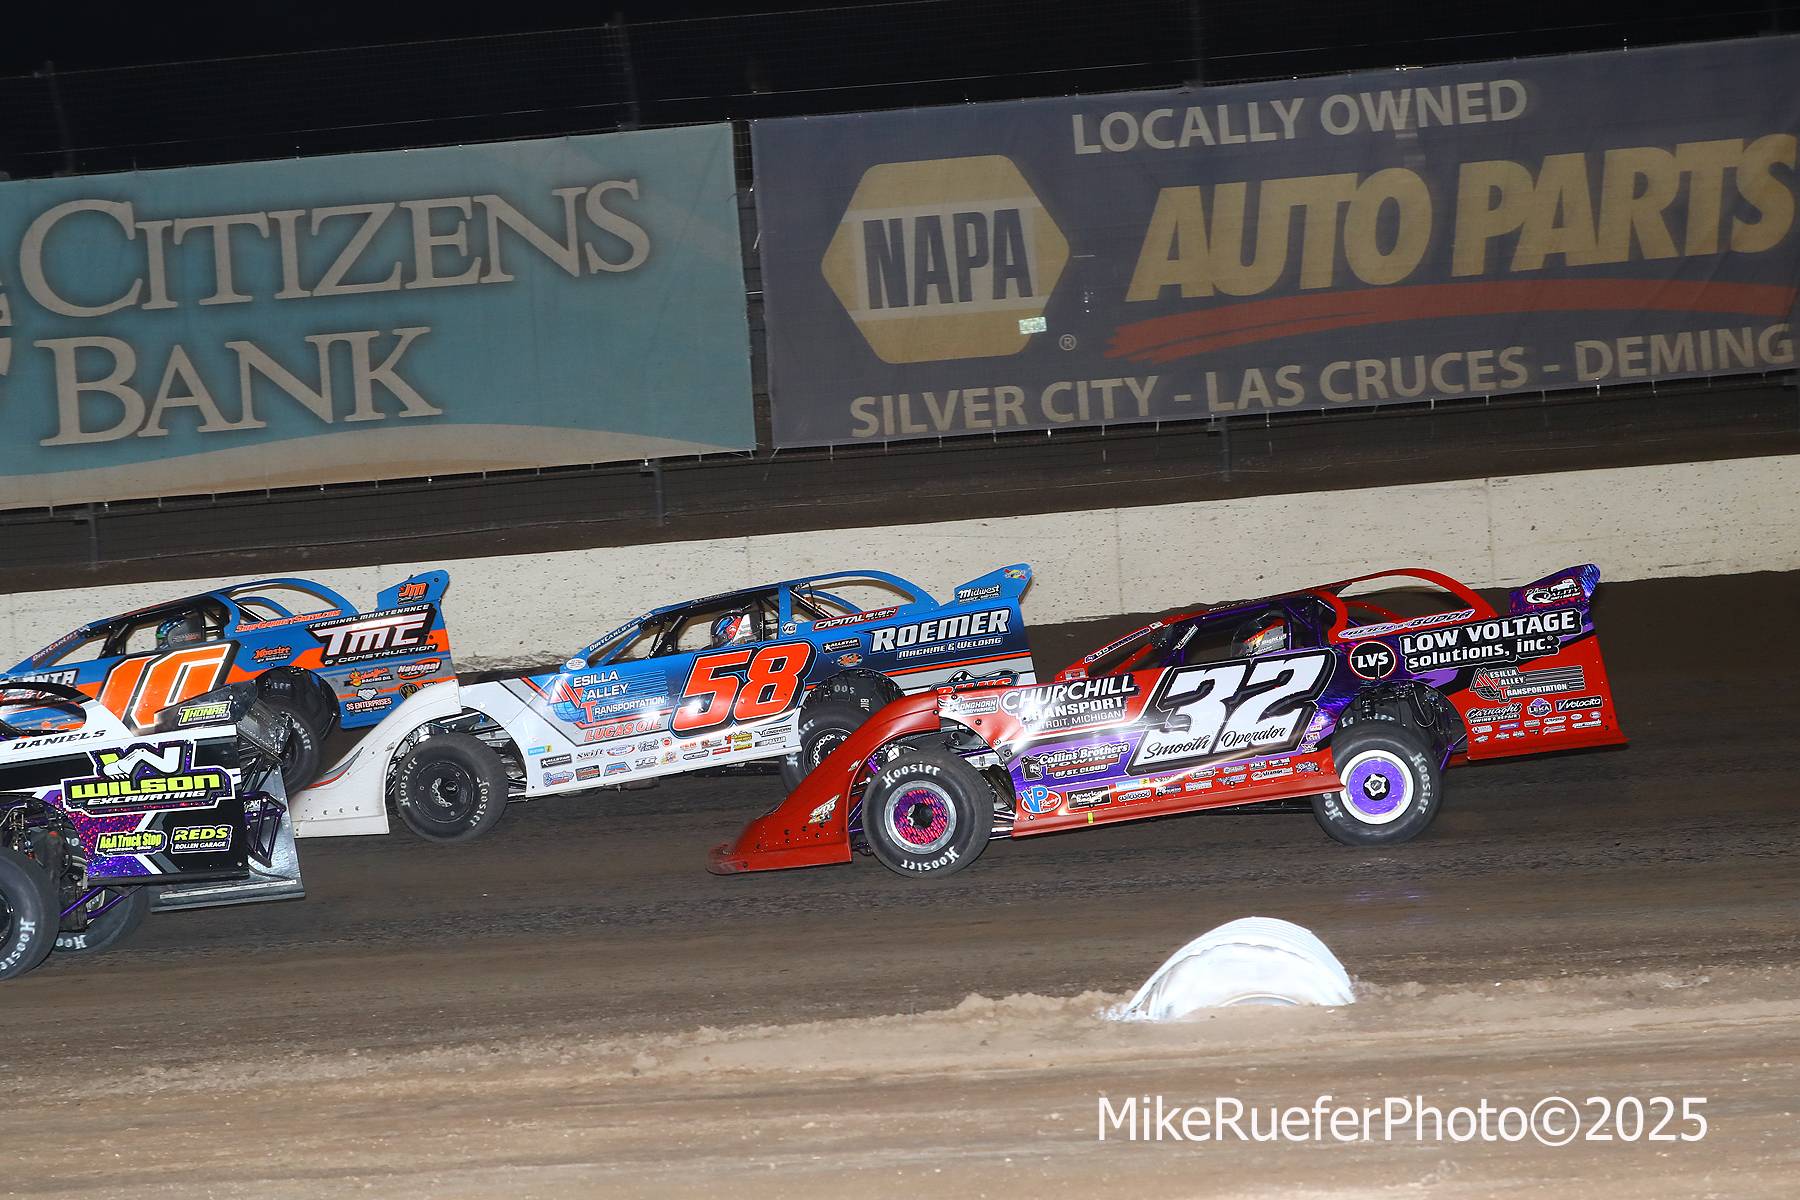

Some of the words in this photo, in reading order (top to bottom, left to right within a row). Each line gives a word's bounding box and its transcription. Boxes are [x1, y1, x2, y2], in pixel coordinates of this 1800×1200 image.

[1073, 96, 1304, 155] LOCALLY
[1320, 79, 1527, 137] OWNED
[1126, 167, 1432, 302] AUTO
[1452, 133, 1797, 278] PARTS
[20, 177, 651, 318] CITIZENS
[861, 209, 1033, 309] NAPA
[33, 326, 443, 447] BANK
[850, 380, 1027, 438] SILVER
[1040, 374, 1160, 424] CITY
[1207, 363, 1305, 412] LAS
[1312, 347, 1529, 403] CRUCES
[1577, 321, 1795, 382] DEMING
[958, 584, 999, 598] Midwest
[309, 617, 358, 629] TERMINAL
[360, 604, 430, 619] MAINTENANCE
[815, 615, 865, 629] CAPITAL
[312, 612, 428, 656] TMC
[871, 609, 1010, 652] ROEMER
[1403, 630, 1459, 654] LOW
[1466, 611, 1576, 642] VOLTAGE
[338, 644, 437, 663] CONSTRUCTION
[898, 644, 946, 658] MACHINE
[957, 637, 1002, 649] WELDING
[1357, 652, 1388, 669] LVS
[1408, 643, 1510, 669] solutions,
[672, 642, 811, 732] 58
[1002, 676, 1135, 710] CHURCHILL
[355, 698, 392, 709] ENTERPRISES
[1132, 654, 1327, 767] 32
[584, 724, 634, 741] LUCAS
[636, 719, 662, 733] OIL
[1072, 710, 1122, 725] MICHIGAN
[12, 729, 107, 750] DANIELS
[1143, 733, 1212, 760] Smooth
[1221, 725, 1287, 749] Operator
[1039, 751, 1078, 765] Collins
[1080, 743, 1129, 758] Brothers
[1048, 754, 1119, 768] TOWING
[881, 761, 941, 789] Hoosier
[1080, 764, 1107, 772] CLOUD
[71, 774, 220, 799] WILSON
[400, 757, 419, 808] Hoosier
[1409, 752, 1434, 815] Hoosier
[87, 790, 206, 806] EXCAVATING
[469, 780, 490, 828] Hoosier
[1021, 786, 1048, 812] VP
[118, 833, 142, 848] Truck
[142, 832, 162, 846] Stop
[174, 827, 229, 841] REDS
[901, 845, 960, 873] Hoosier
